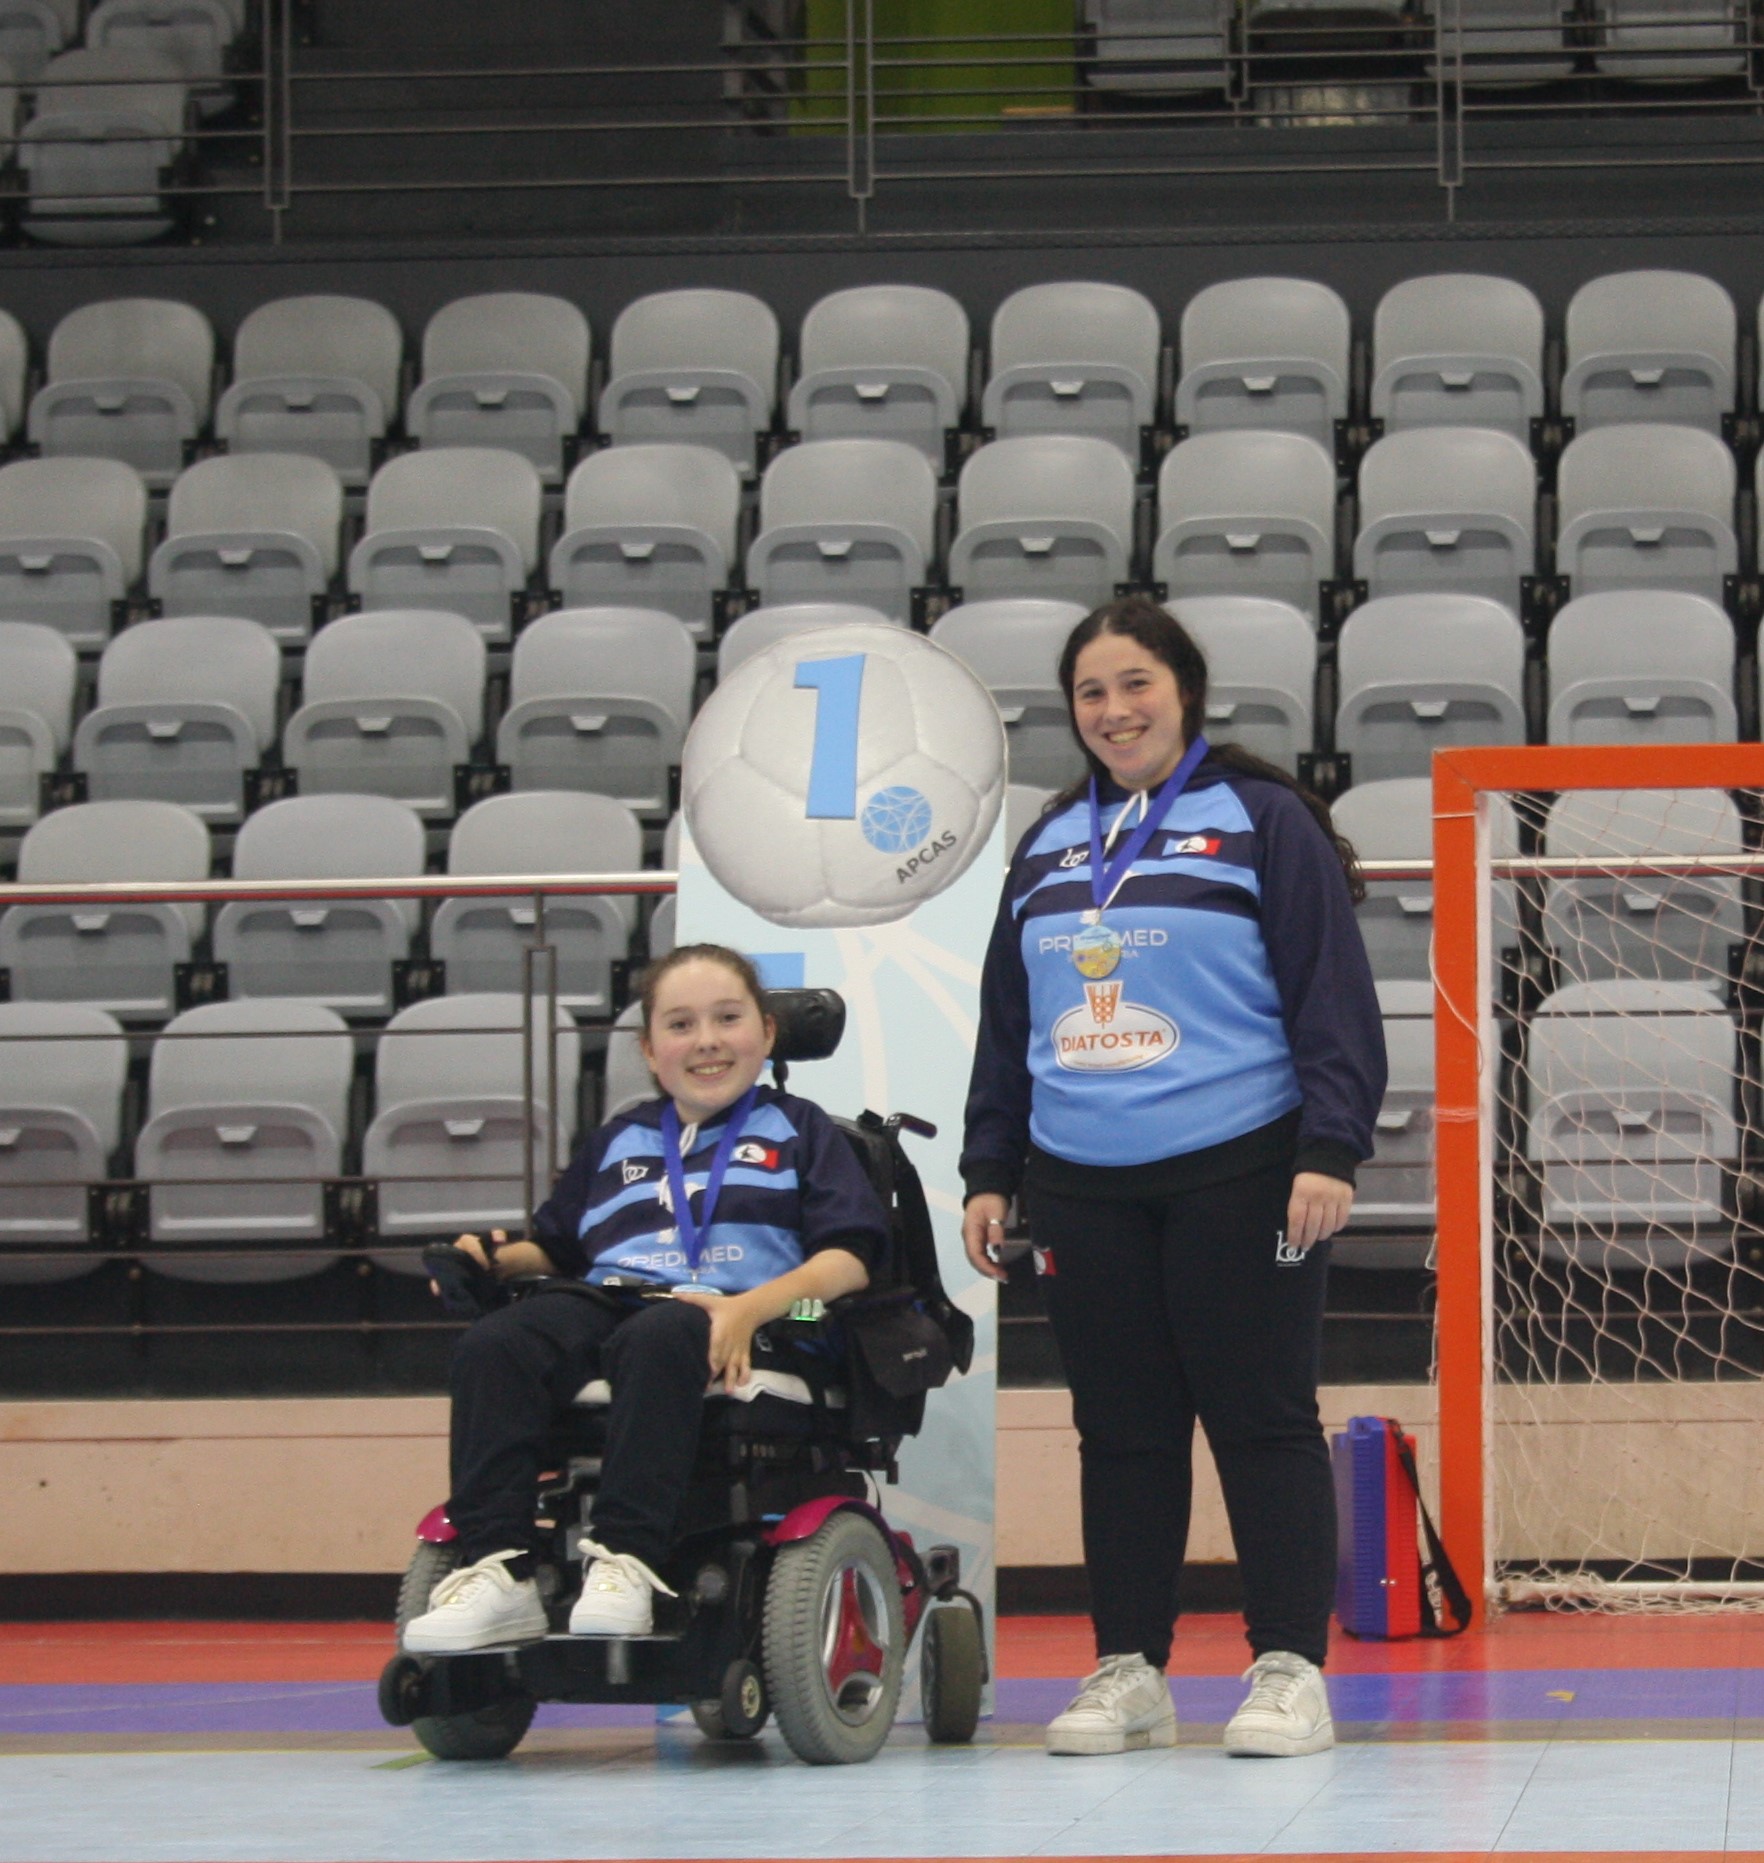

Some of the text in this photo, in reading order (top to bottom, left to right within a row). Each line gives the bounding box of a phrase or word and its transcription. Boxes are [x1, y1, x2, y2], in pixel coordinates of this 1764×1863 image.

[794, 653, 867, 820] 1
[897, 830, 956, 885] APCAS
[1039, 929, 1168, 955] PRMED
[1060, 1030, 1165, 1053] DIATOSTA
